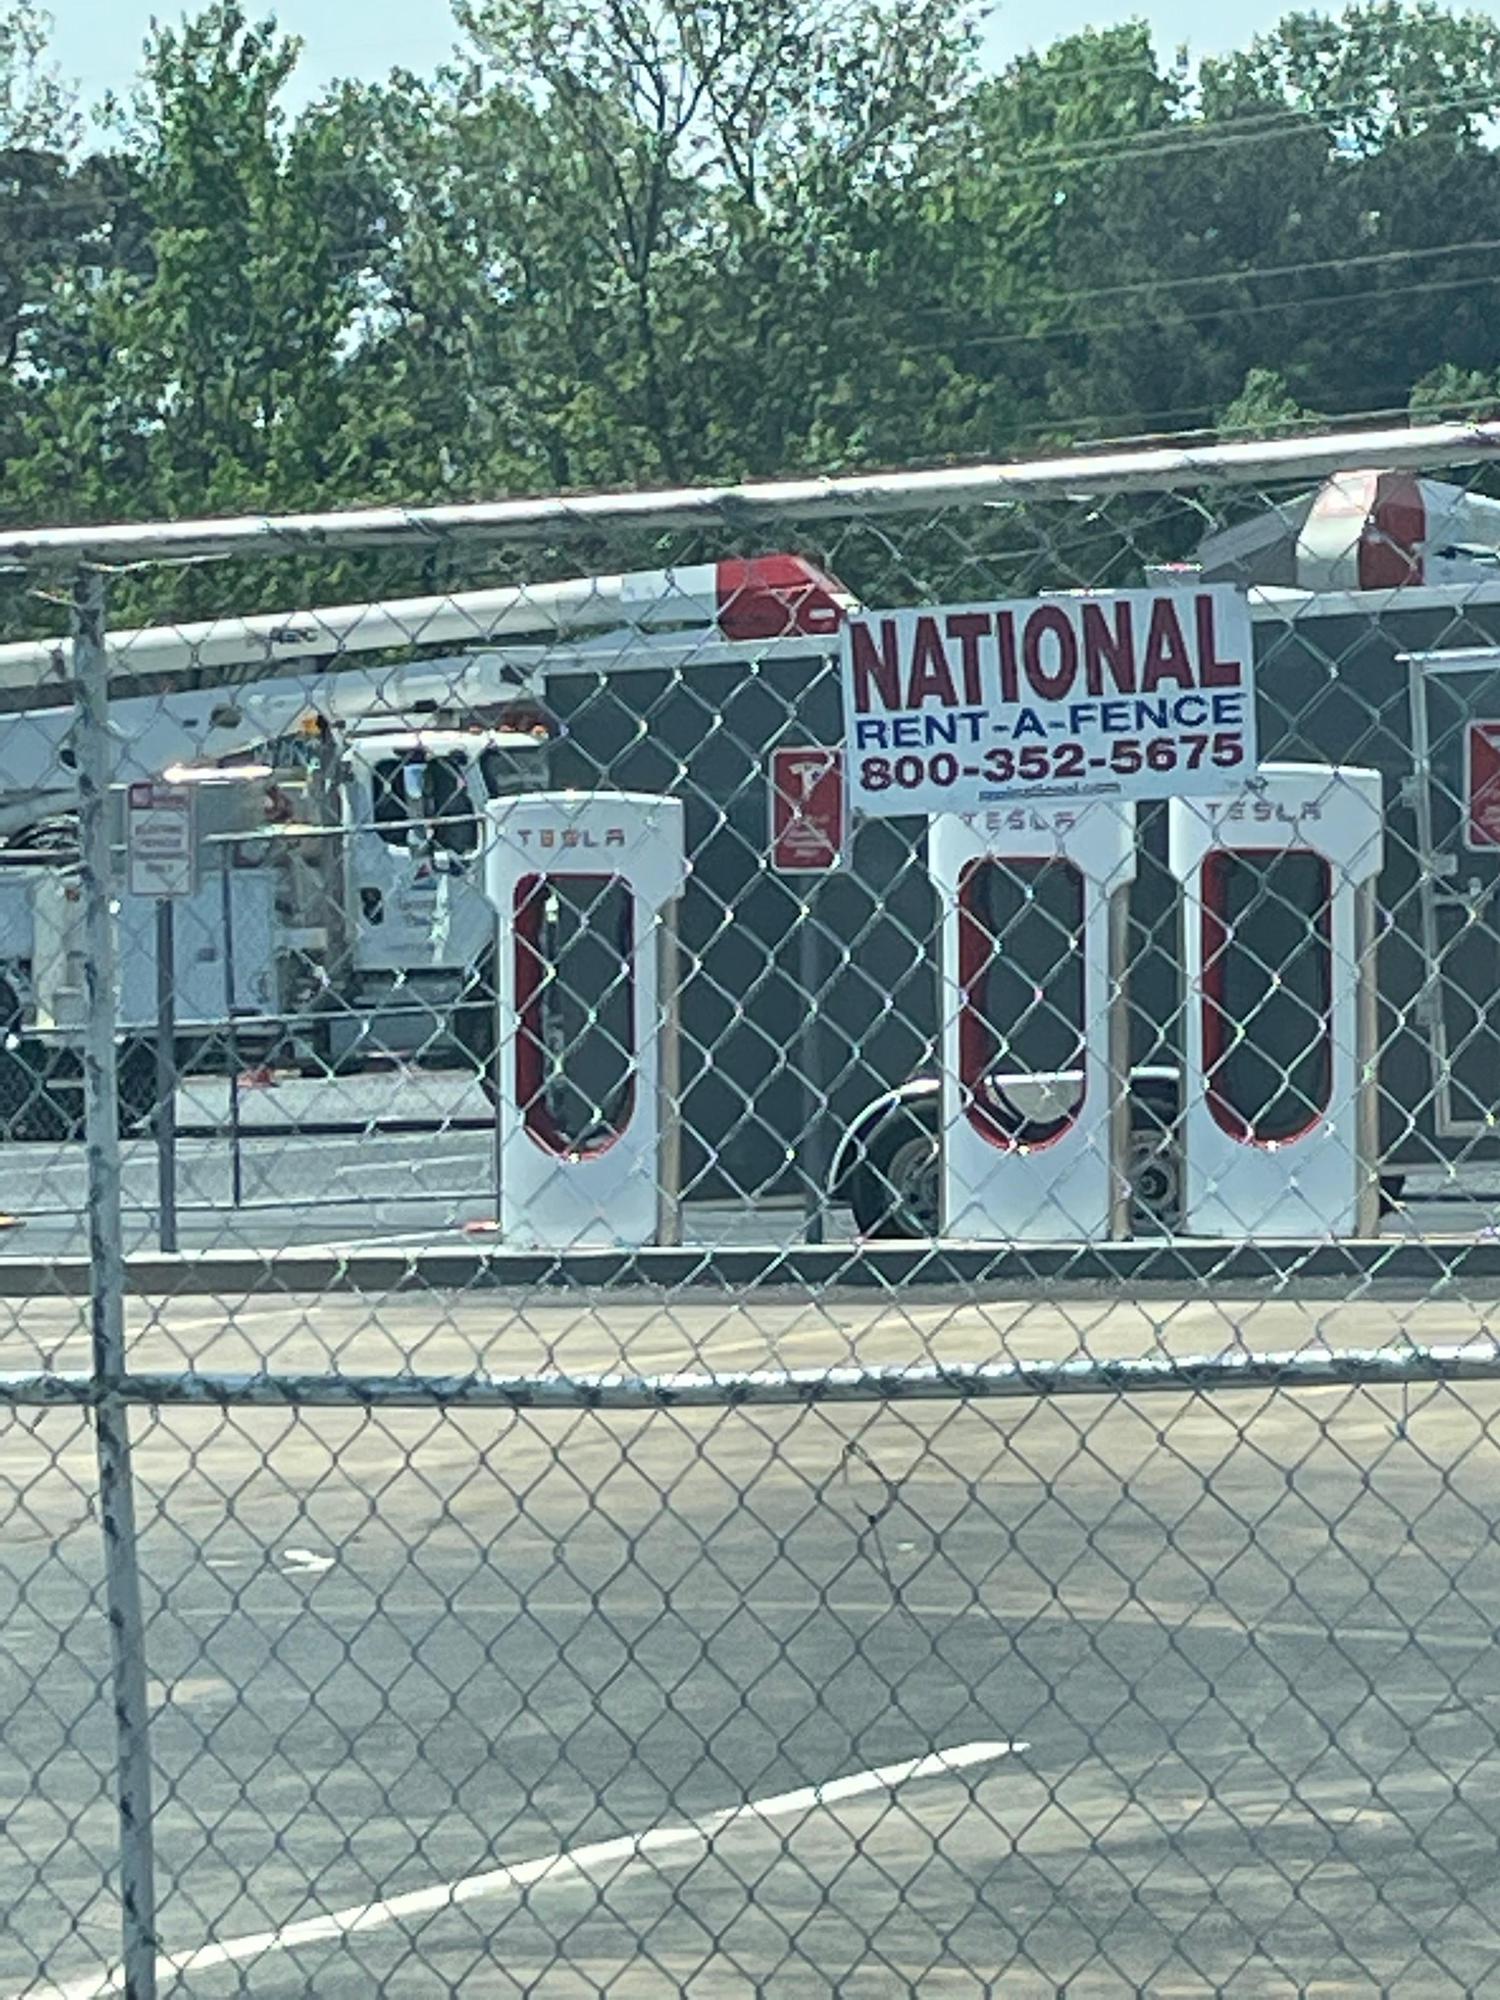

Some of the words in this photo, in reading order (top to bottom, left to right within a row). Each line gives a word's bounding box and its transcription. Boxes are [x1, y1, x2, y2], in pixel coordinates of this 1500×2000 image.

[849, 594, 1242, 714] NATIONAL
[856, 692, 1247, 750] RENT-A-FENCE
[860, 733, 1244, 791] 800-352-5675
[962, 809, 1077, 830] TESLA
[1205, 801, 1322, 821] TESLA
[518, 829, 626, 848] TESLA
